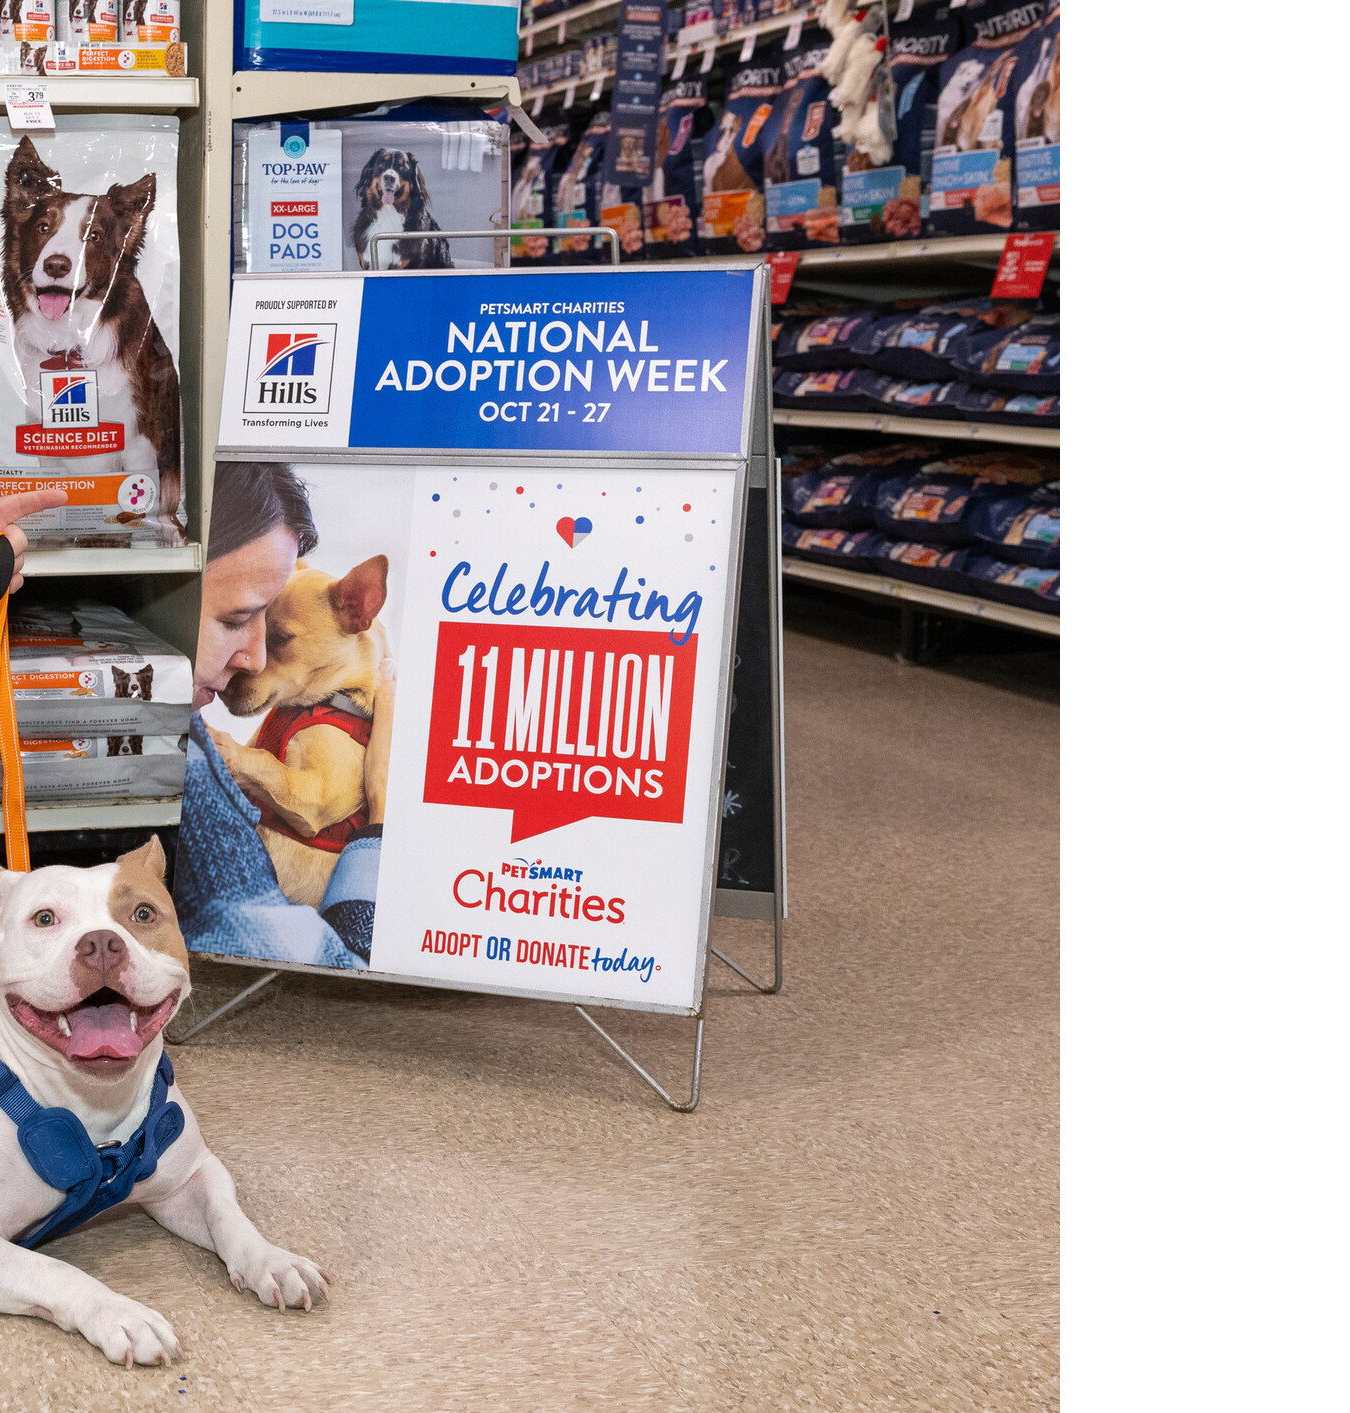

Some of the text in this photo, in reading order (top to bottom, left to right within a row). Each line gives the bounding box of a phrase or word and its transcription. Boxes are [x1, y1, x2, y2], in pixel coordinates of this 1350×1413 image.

[273, 204, 316, 213] XX-LARGE
[272, 223, 318, 240] DOG
[270, 243, 322, 260] PADS
[255, 300, 337, 310] PROUDLY SUPPORTED BY
[480, 301, 625, 315] PETSMART CHARITIES
[446, 320, 659, 354] NATIONAL
[374, 358, 729, 392] ADOPTION WEEK
[258, 382, 317, 404] Hill's
[51, 408, 90, 422] Hill's
[479, 402, 532, 423] OCT
[538, 402, 560, 422] 21
[584, 402, 611, 422] 27
[242, 419, 328, 428] Transforming Lives
[23, 431, 118, 444] SCIENCE DIET
[35, 480, 95, 490] DIGESTION
[441, 560, 704, 646] Celebrating
[452, 646, 674, 762] 11 MILLION
[447, 756, 664, 799] ADOPTIONS
[452, 868, 626, 924] Charities
[421, 930, 482, 960] ADOPT
[486, 935, 512, 962] OR
[516, 940, 590, 971] DONATE
